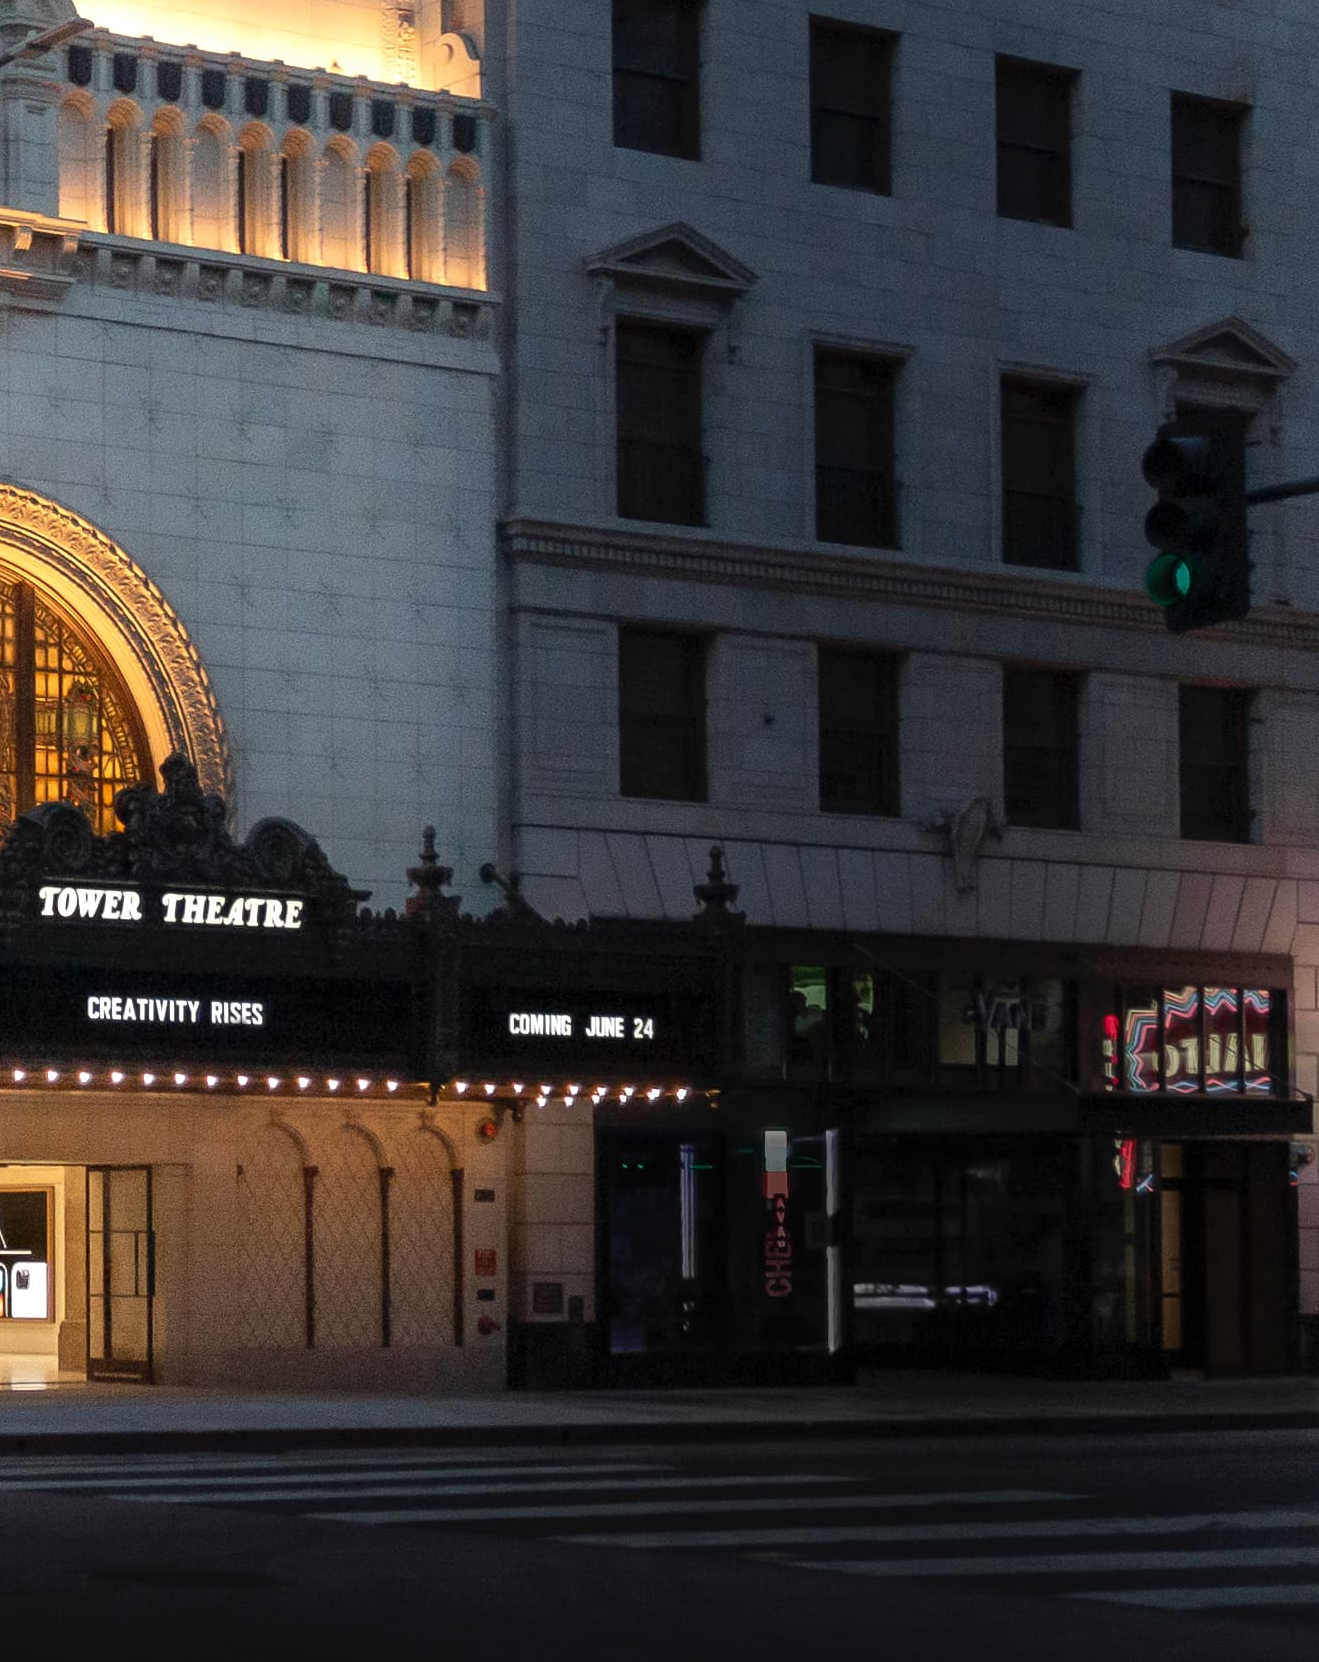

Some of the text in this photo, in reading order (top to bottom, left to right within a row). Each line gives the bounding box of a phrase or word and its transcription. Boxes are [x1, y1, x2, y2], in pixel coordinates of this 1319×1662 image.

[39, 887, 303, 929] TOWER THEATRE
[87, 995, 263, 1025] CREATIVITY RISES
[509, 1012, 654, 1039] COMING JUNE 24
